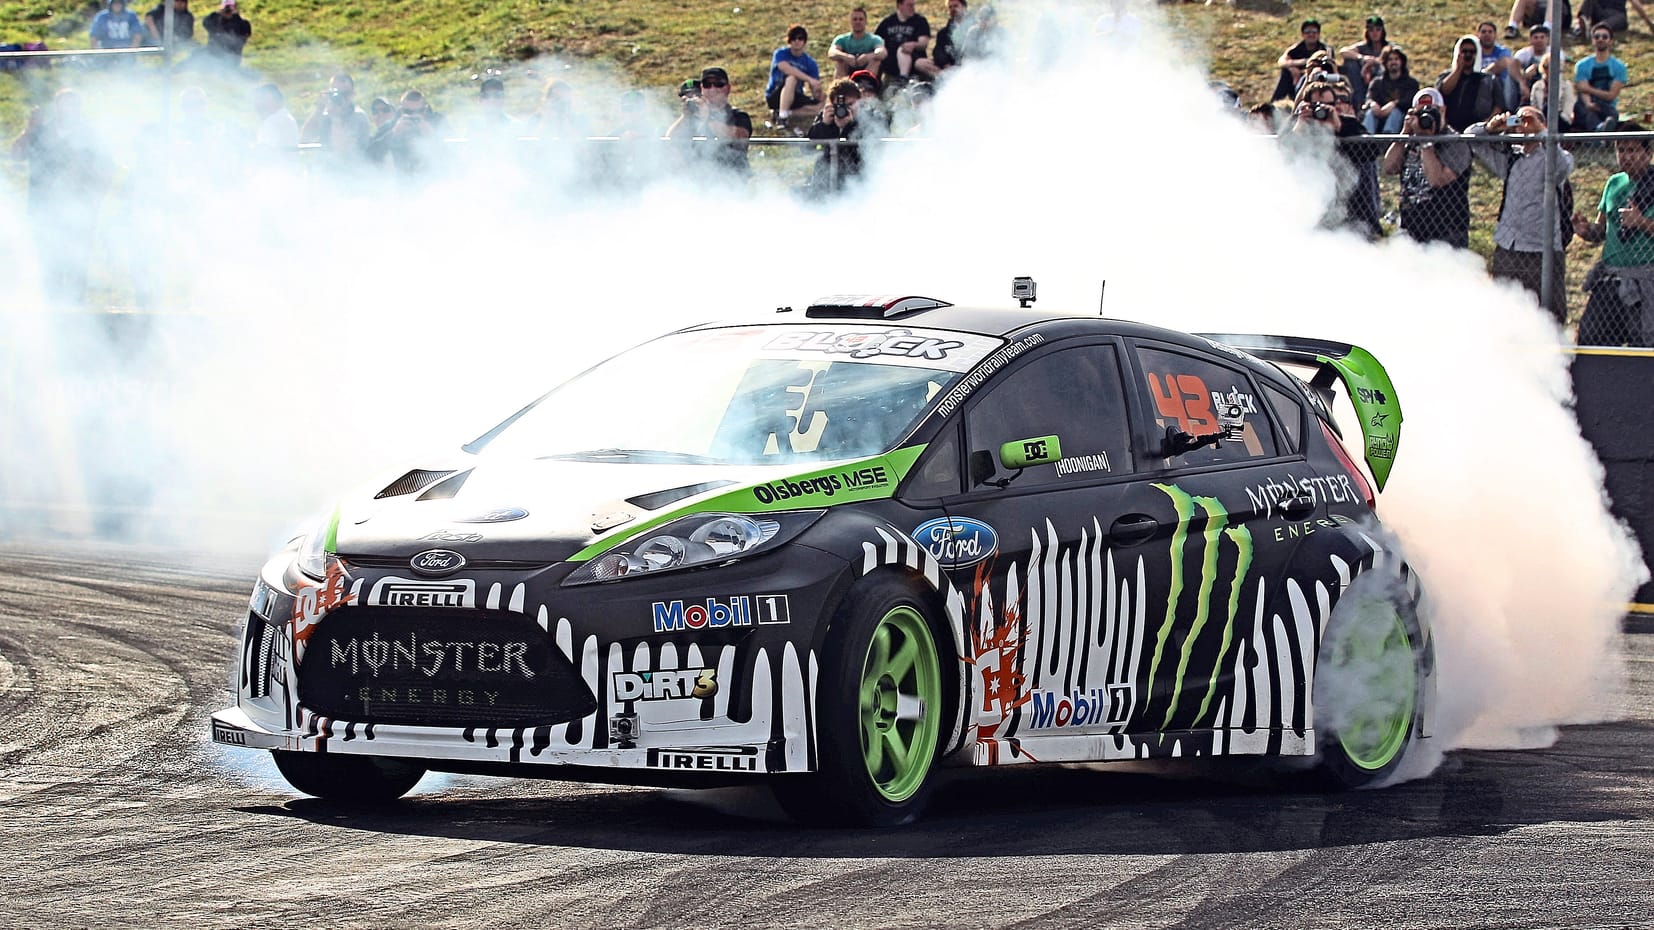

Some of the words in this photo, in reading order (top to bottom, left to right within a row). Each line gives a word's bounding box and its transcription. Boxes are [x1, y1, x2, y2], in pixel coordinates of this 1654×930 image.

[937, 333, 1045, 418] monsterworldrallyteam.com
[1148, 372, 1221, 441] 43
[1023, 440, 1048, 461] DC
[753, 473, 842, 504] Olsbergs
[841, 466, 887, 488] MSE
[420, 552, 452, 567] Ford
[929, 524, 982, 561] Ford
[378, 583, 468, 607] PIRELLI
[652, 596, 752, 632] Mobil
[330, 631, 536, 679] MONSTER
[359, 687, 499, 705] ENERGY
[1030, 688, 1104, 729] Mobil
[647, 746, 758, 771] PIRELLI
